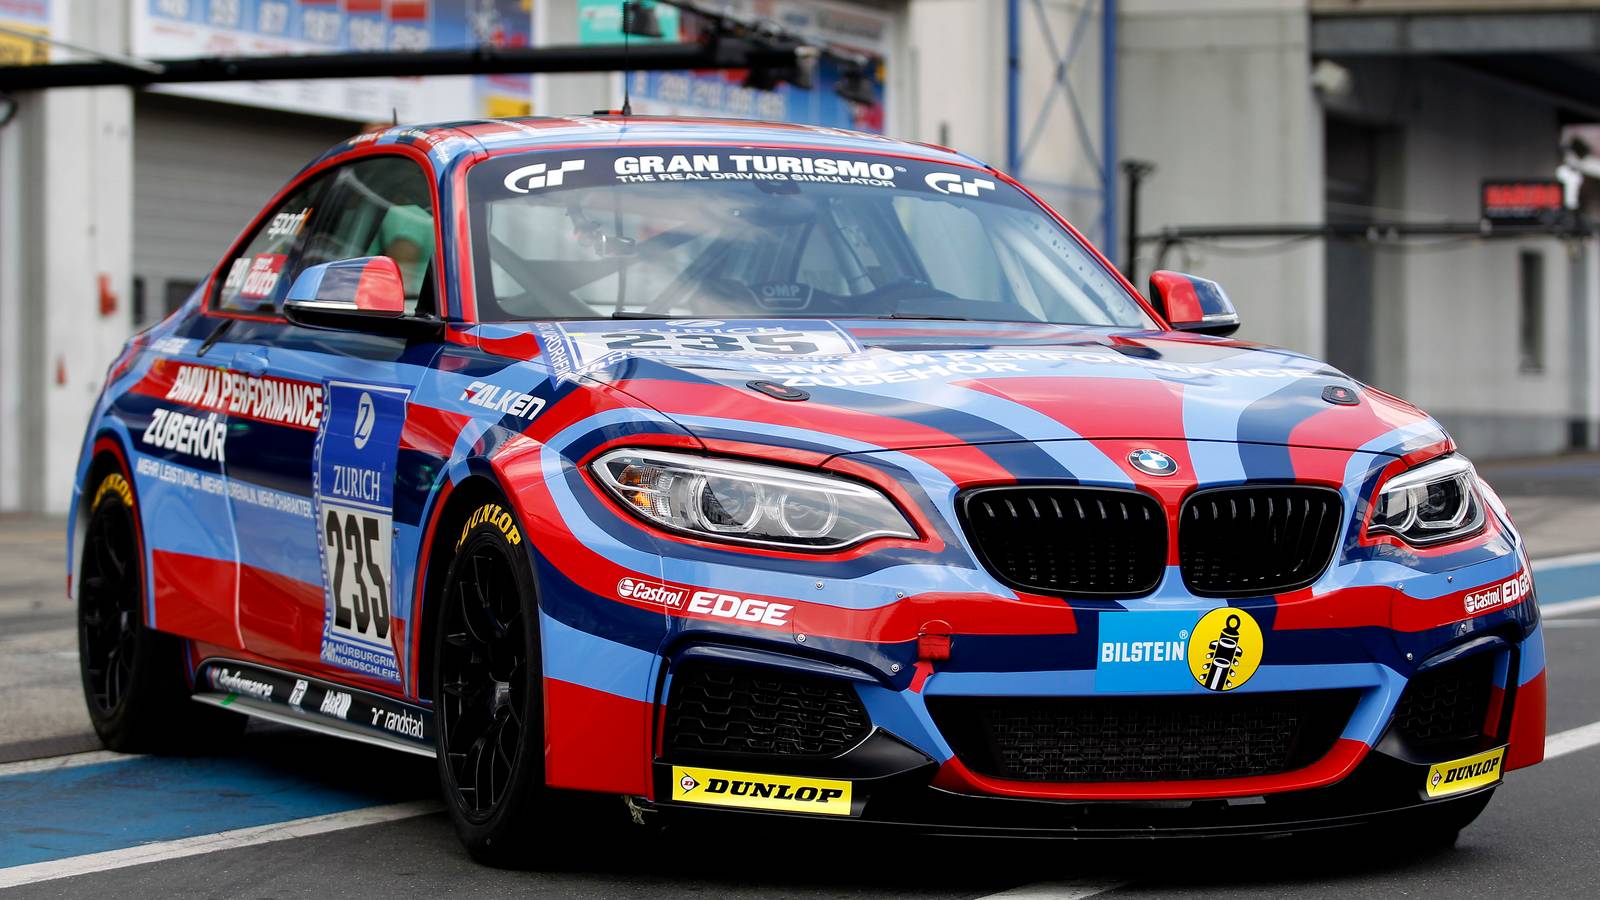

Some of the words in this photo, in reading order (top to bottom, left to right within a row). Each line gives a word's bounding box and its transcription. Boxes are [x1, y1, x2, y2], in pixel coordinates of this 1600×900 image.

[613, 154, 719, 176] GRAN
[615, 172, 658, 184] THE
[659, 172, 709, 182] REAL
[711, 172, 789, 182] DRIVING
[790, 173, 896, 188] SIMULATOR
[761, 285, 801, 297] OMP
[600, 333, 819, 355] 235
[165, 365, 209, 405] BMW
[202, 369, 221, 408] M
[216, 372, 323, 429] PERFORMANCE
[459, 380, 546, 421] FALKEN
[141, 407, 228, 463] ZUBEHÖR
[136, 457, 161, 479] MEHR
[332, 464, 381, 503] ZURICH
[459, 503, 521, 546] DUNLOP
[325, 508, 390, 640] 235
[633, 582, 684, 608] Castrol
[687, 590, 794, 626] EDGE
[1474, 587, 1501, 610] Castrol
[335, 643, 398, 669] NÜRBURGRIN
[384, 708, 424, 739] randstad
[1444, 756, 1500, 784] DUNLOP
[704, 777, 845, 804] DUNLOP
